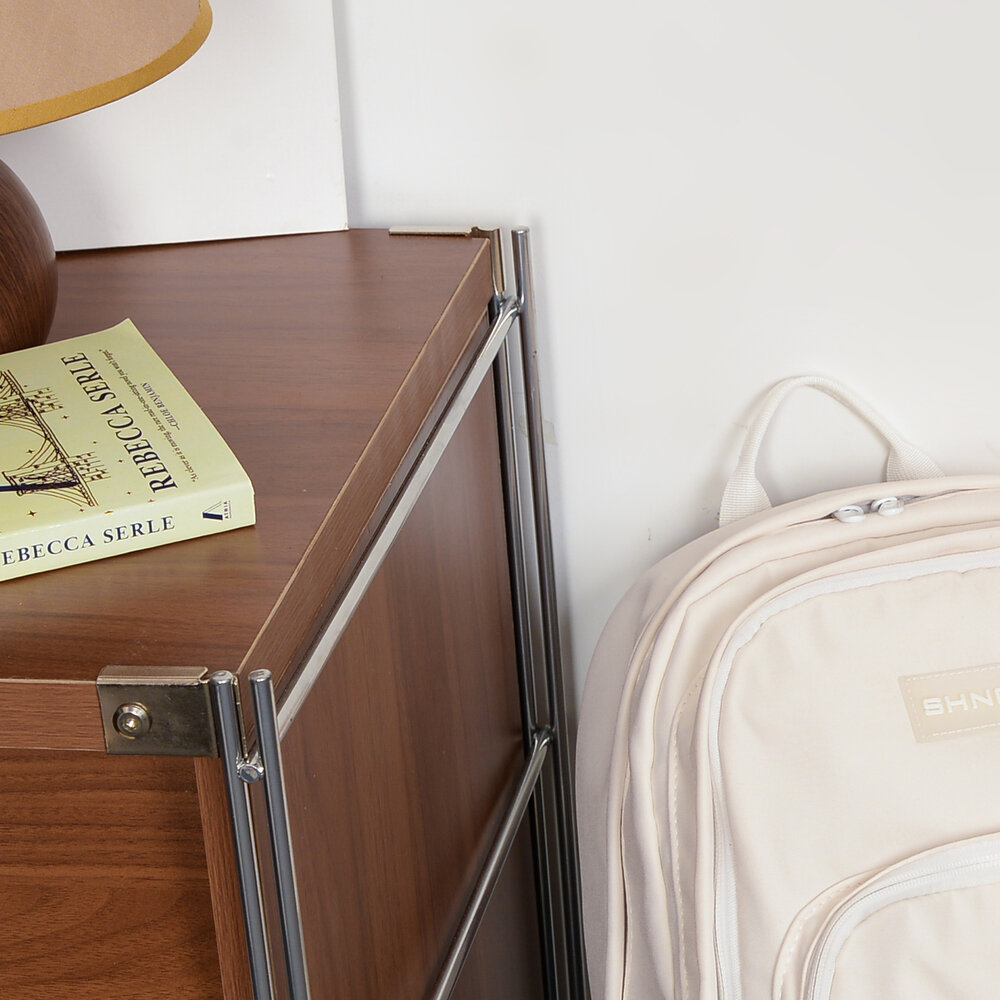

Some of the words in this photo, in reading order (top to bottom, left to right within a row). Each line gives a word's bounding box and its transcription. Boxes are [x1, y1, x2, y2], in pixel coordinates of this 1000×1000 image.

[61, 352, 117, 402] SERLE
[101, 403, 178, 493] REBECCA
[0, 533, 96, 566] EBECCA
[103, 515, 176, 544] SERLE
